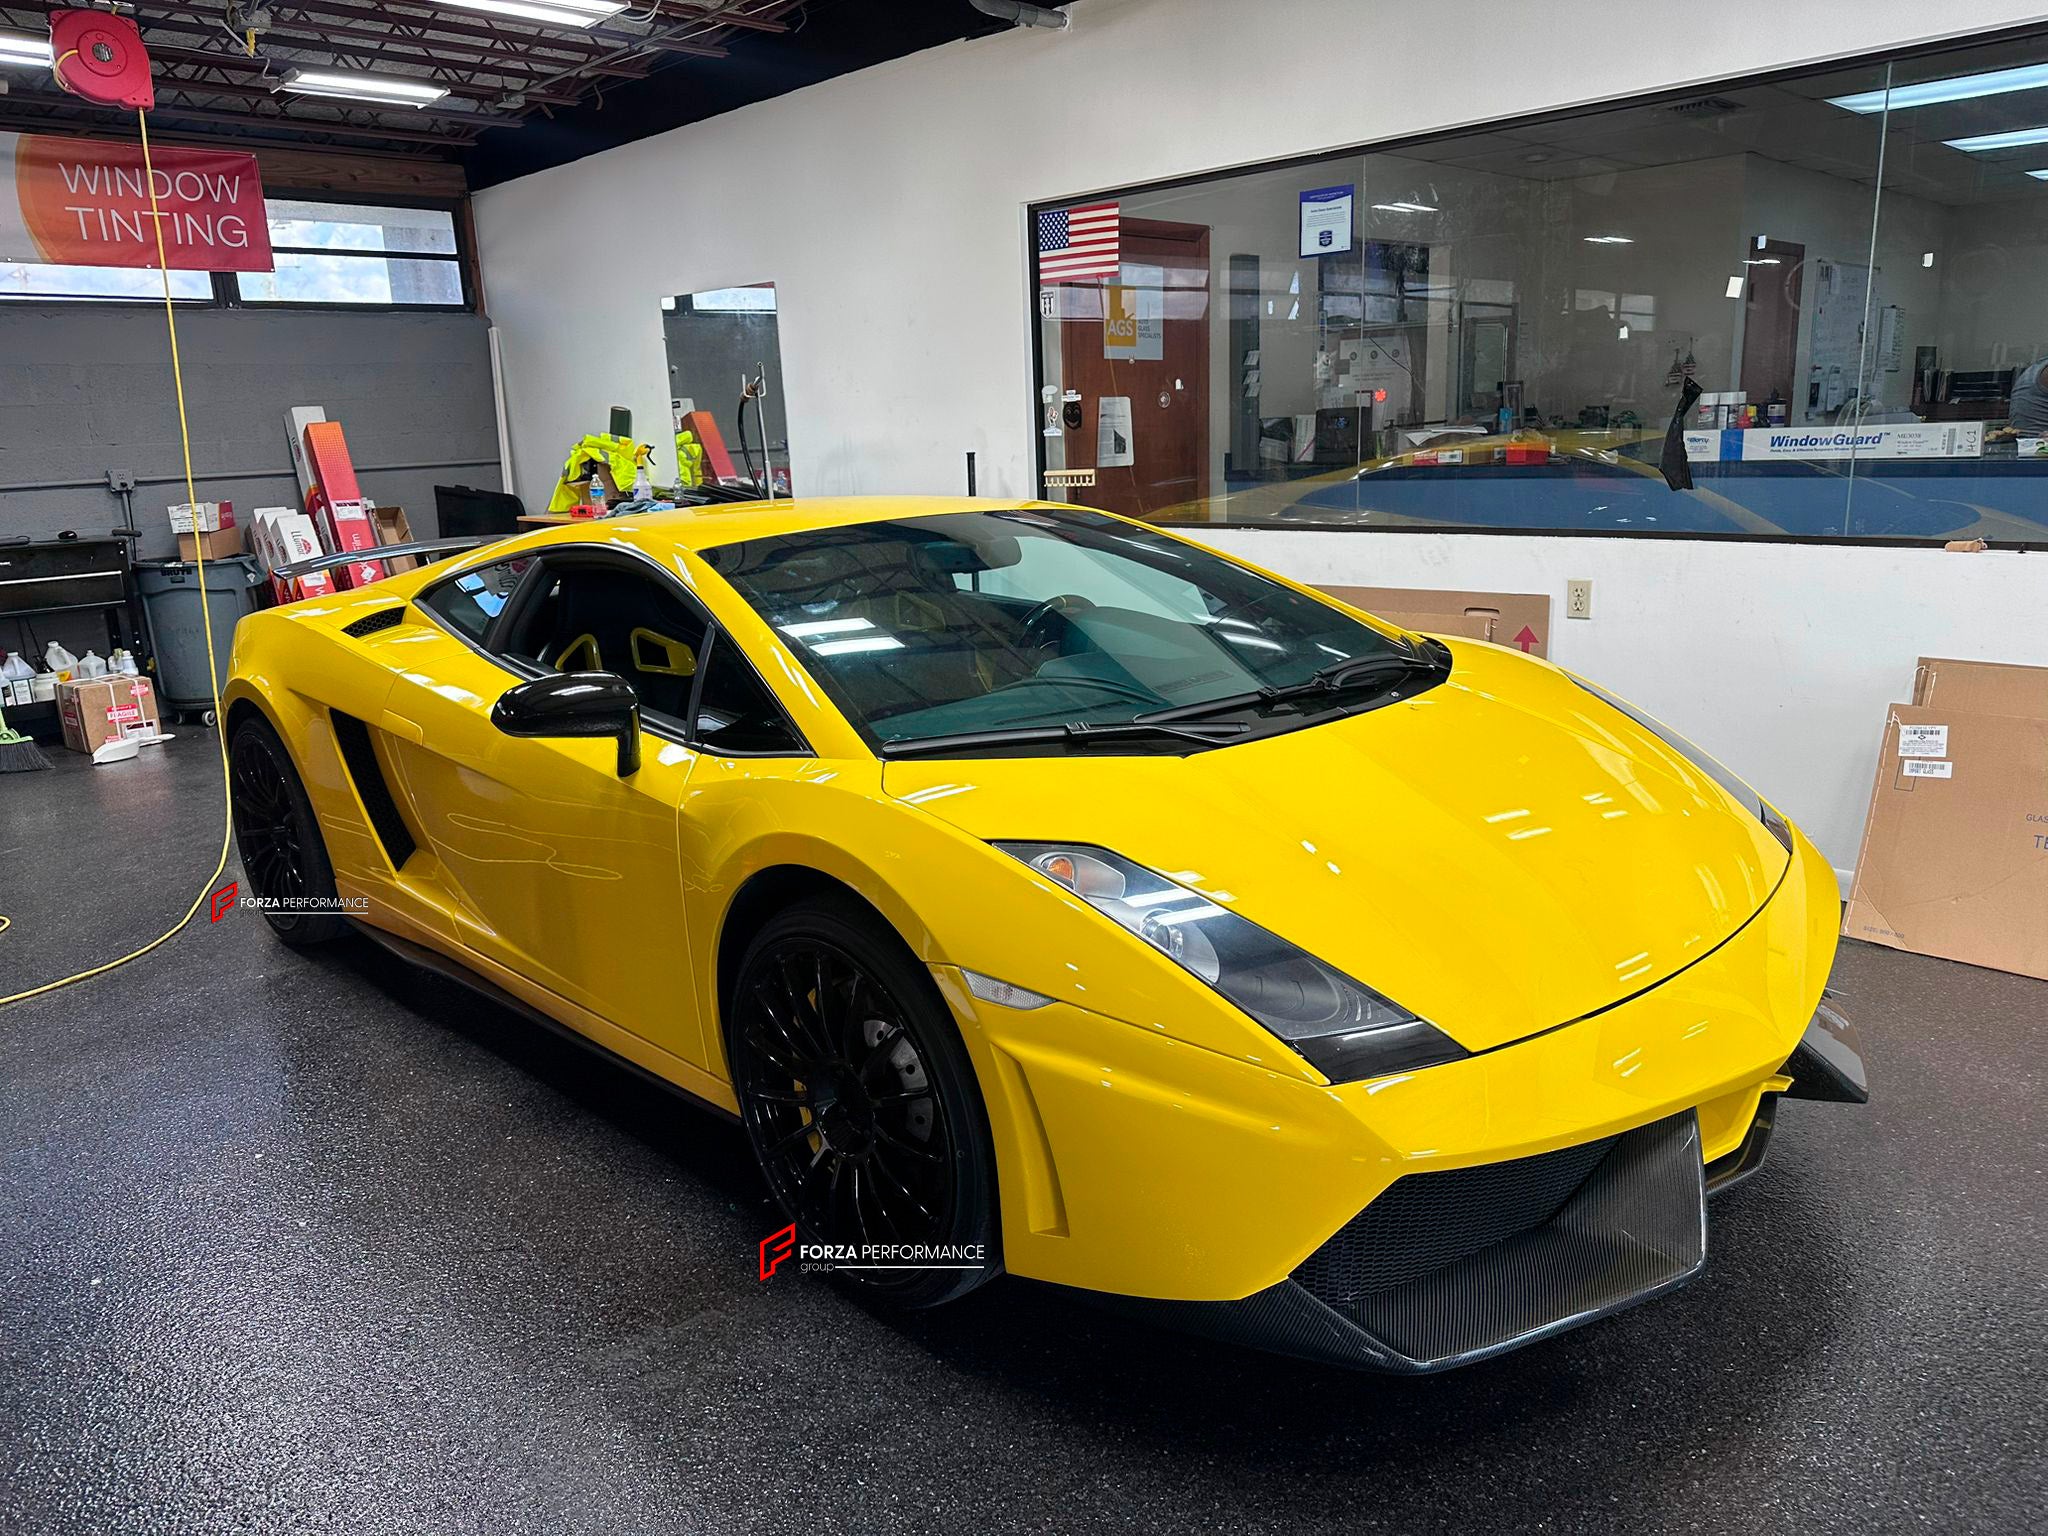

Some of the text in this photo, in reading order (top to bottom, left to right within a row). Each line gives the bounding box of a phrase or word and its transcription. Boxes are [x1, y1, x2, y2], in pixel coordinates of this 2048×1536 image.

[58, 162, 241, 205] WINDOW
[65, 206, 249, 248] TINTING
[1107, 319, 1133, 337] AGS
